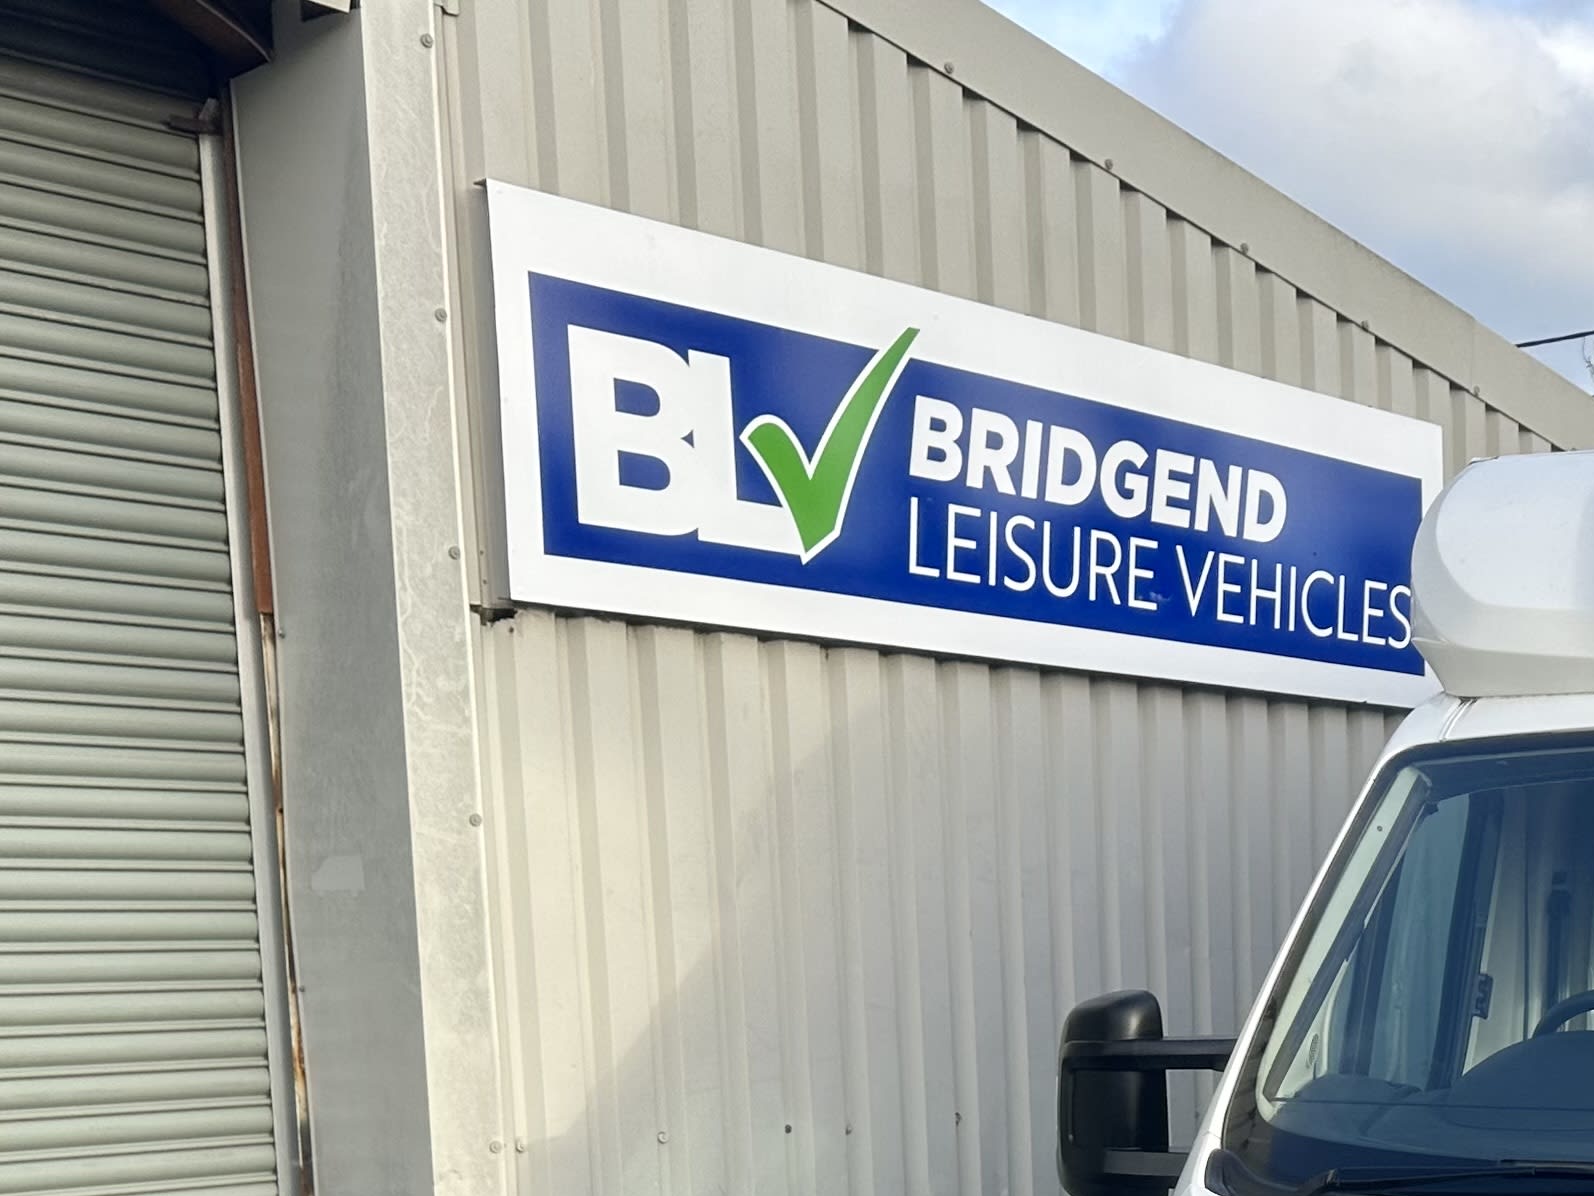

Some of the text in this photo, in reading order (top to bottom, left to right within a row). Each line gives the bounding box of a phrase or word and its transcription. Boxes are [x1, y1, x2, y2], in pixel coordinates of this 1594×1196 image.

[909, 395, 1287, 542] BRIDGEND
[908, 496, 1413, 649] LEISURE VEHICLES
